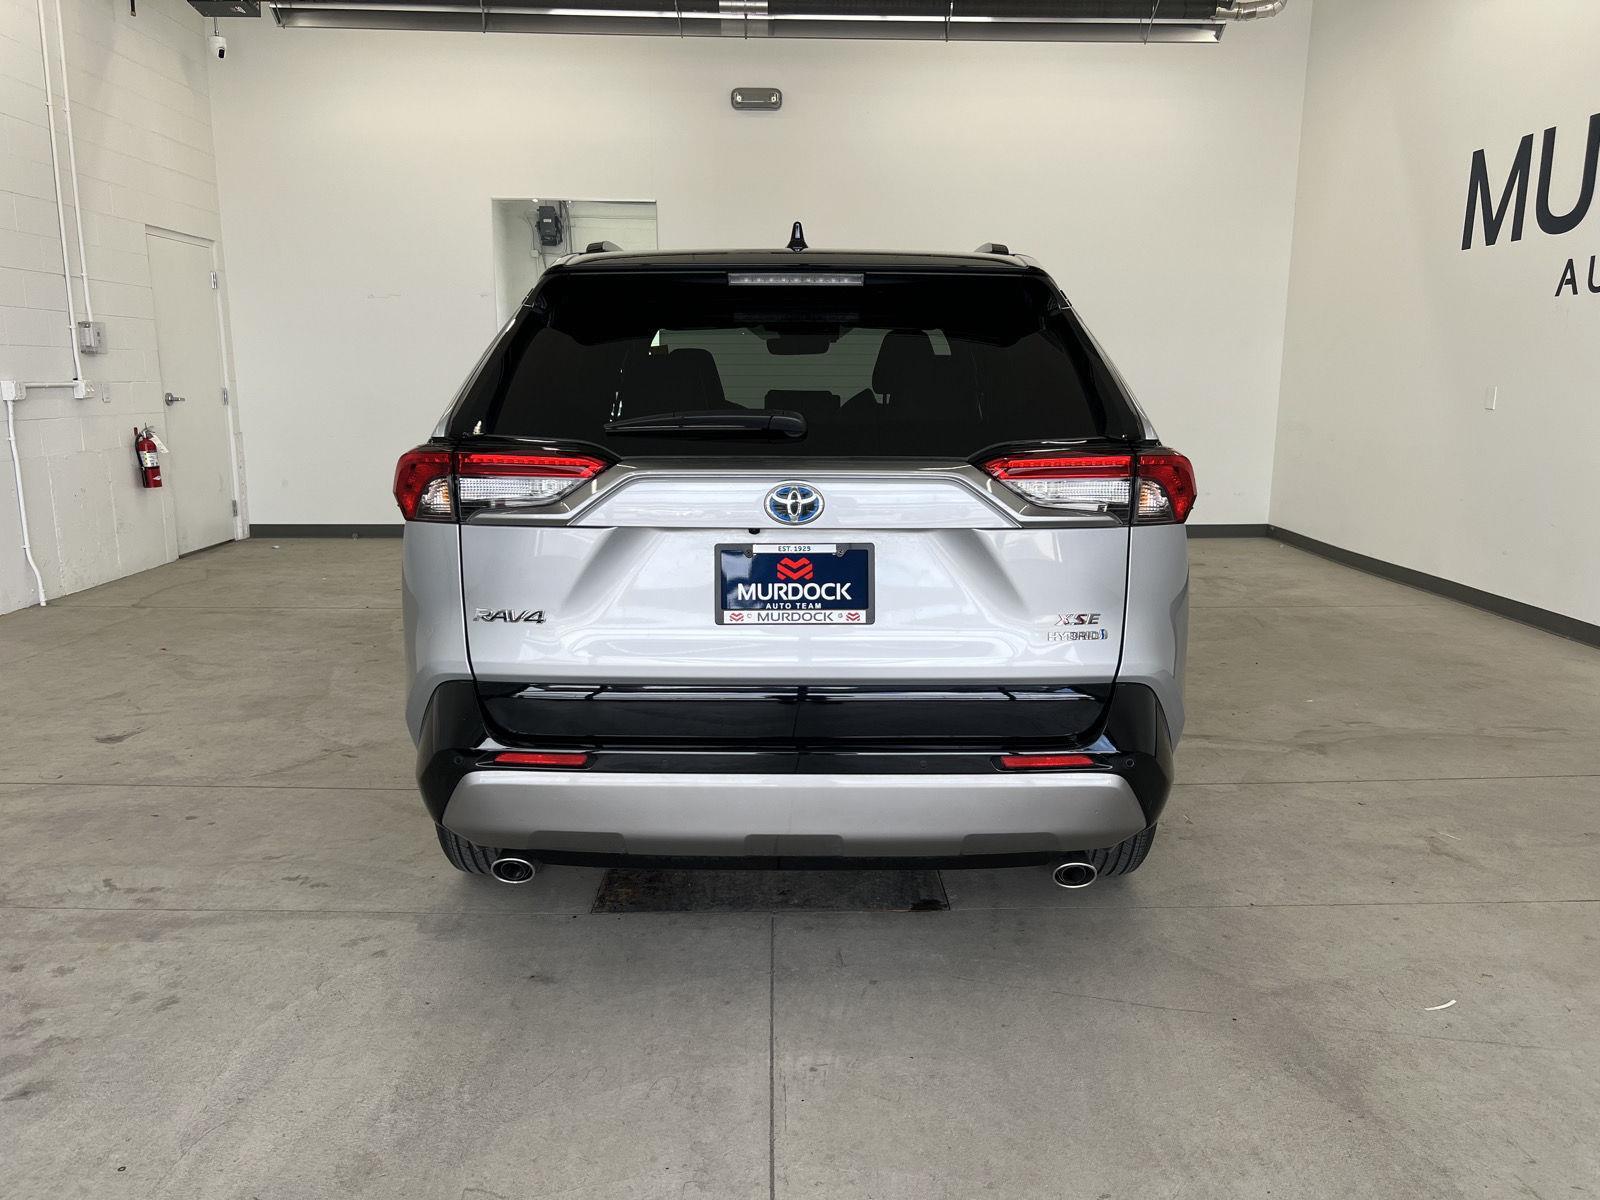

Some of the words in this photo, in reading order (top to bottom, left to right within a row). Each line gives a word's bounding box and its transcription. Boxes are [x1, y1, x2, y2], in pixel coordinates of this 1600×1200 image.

[737, 582, 852, 601] MURDOCK
[765, 602, 792, 610] AUTO
[796, 602, 822, 610] TEAM
[472, 608, 546, 624] RAV4
[757, 612, 834, 622] MURDOCK
[1054, 613, 1101, 626] XSE
[1047, 631, 1100, 641] HYBRID
